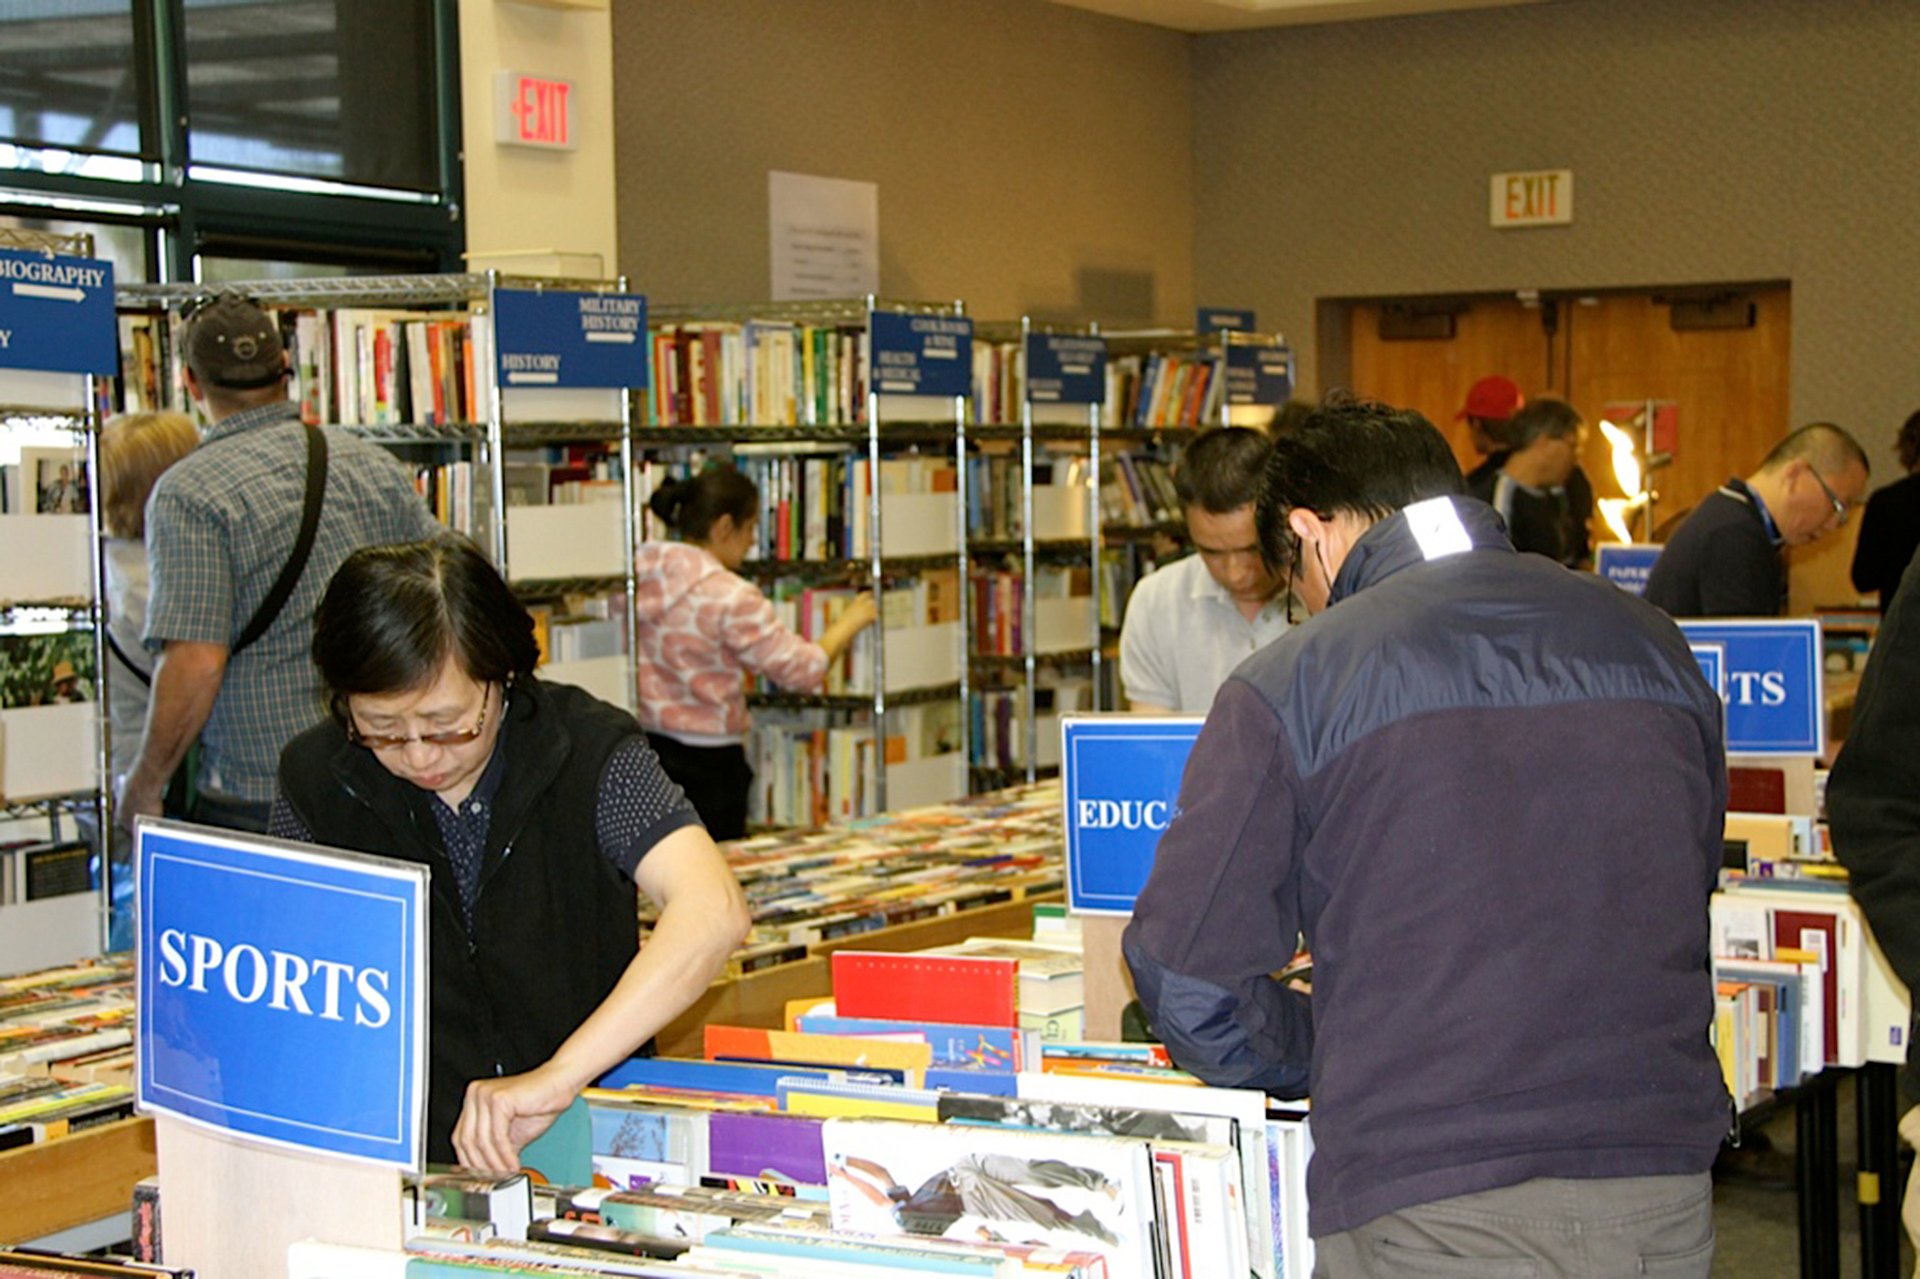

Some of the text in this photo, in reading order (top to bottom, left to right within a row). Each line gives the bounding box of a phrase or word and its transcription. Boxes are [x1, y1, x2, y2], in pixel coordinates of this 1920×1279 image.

[520, 78, 568, 144] EXIT
[1506, 174, 1558, 219] EXIT
[579, 298, 640, 314] MILITARY
[582, 314, 638, 331] HISTORY
[502, 353, 561, 370] HISTORY
[1724, 671, 1786, 706] TS
[1079, 799, 1170, 830] EDUC
[160, 928, 391, 1029] SPORTS
